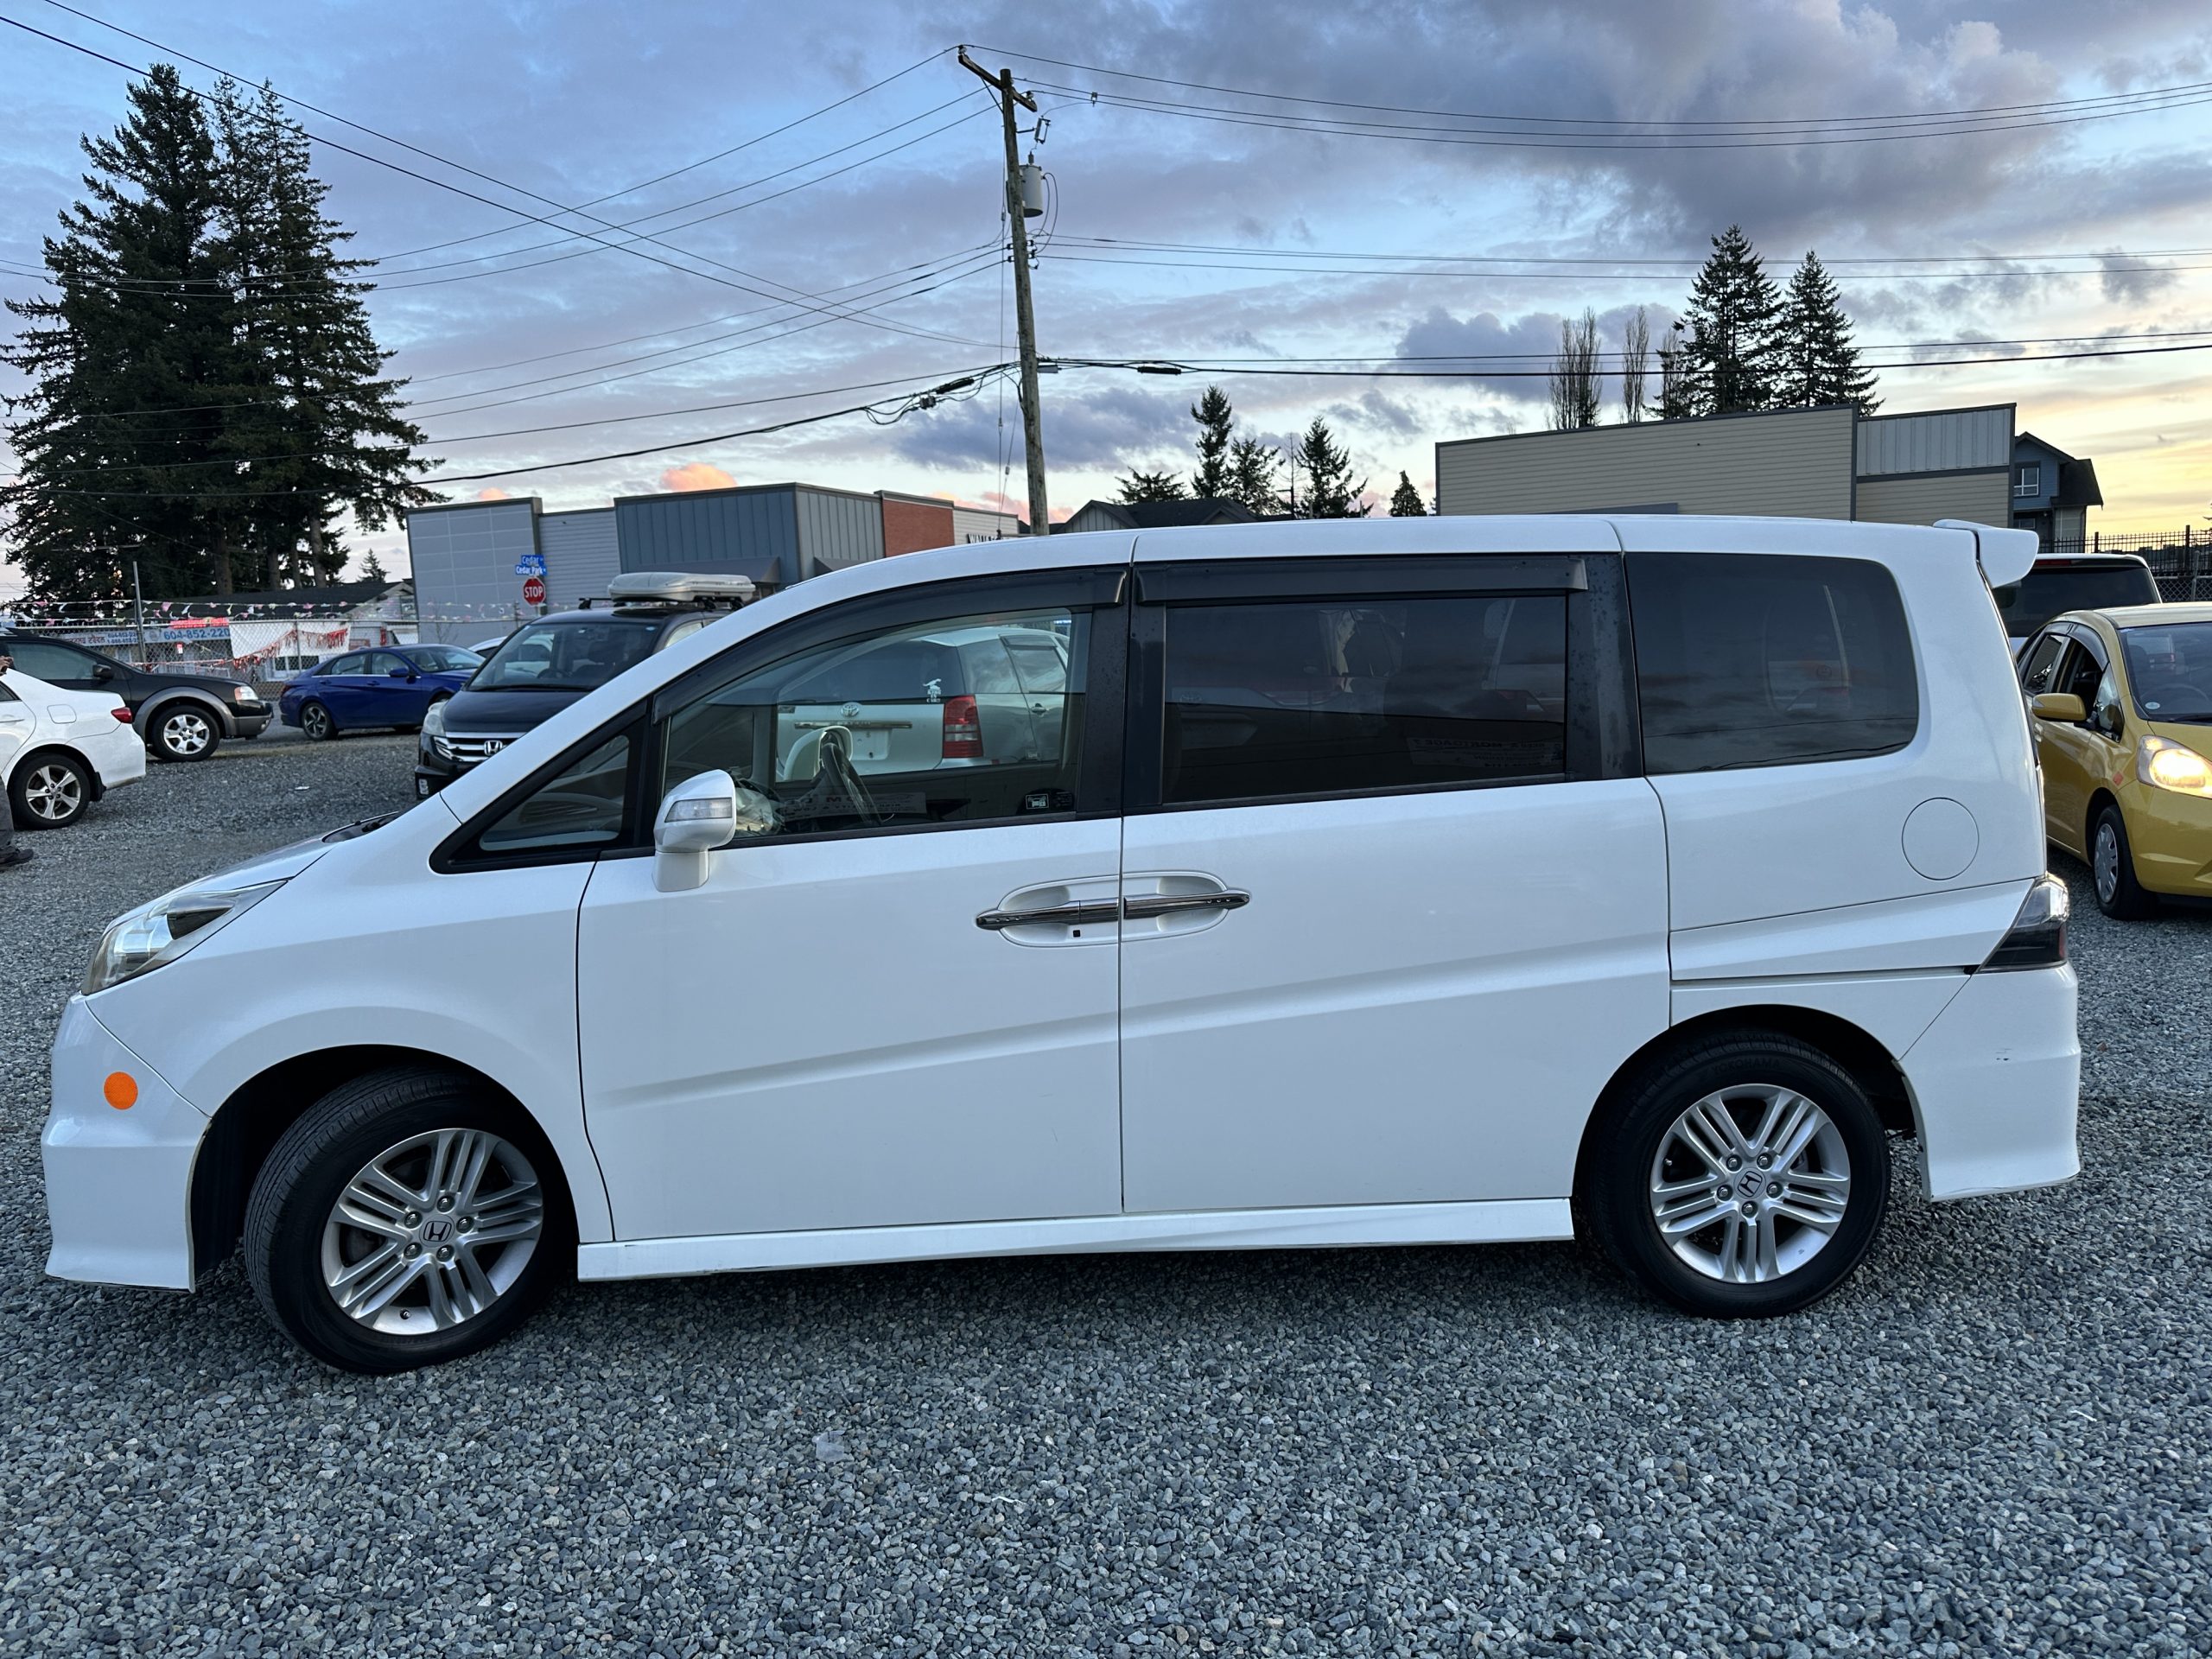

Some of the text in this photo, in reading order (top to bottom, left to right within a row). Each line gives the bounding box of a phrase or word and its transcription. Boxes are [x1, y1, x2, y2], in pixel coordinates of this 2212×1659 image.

[522, 556, 539, 565] Cedar
[531, 566, 543, 575] Park
[524, 586, 543, 598] STOP
